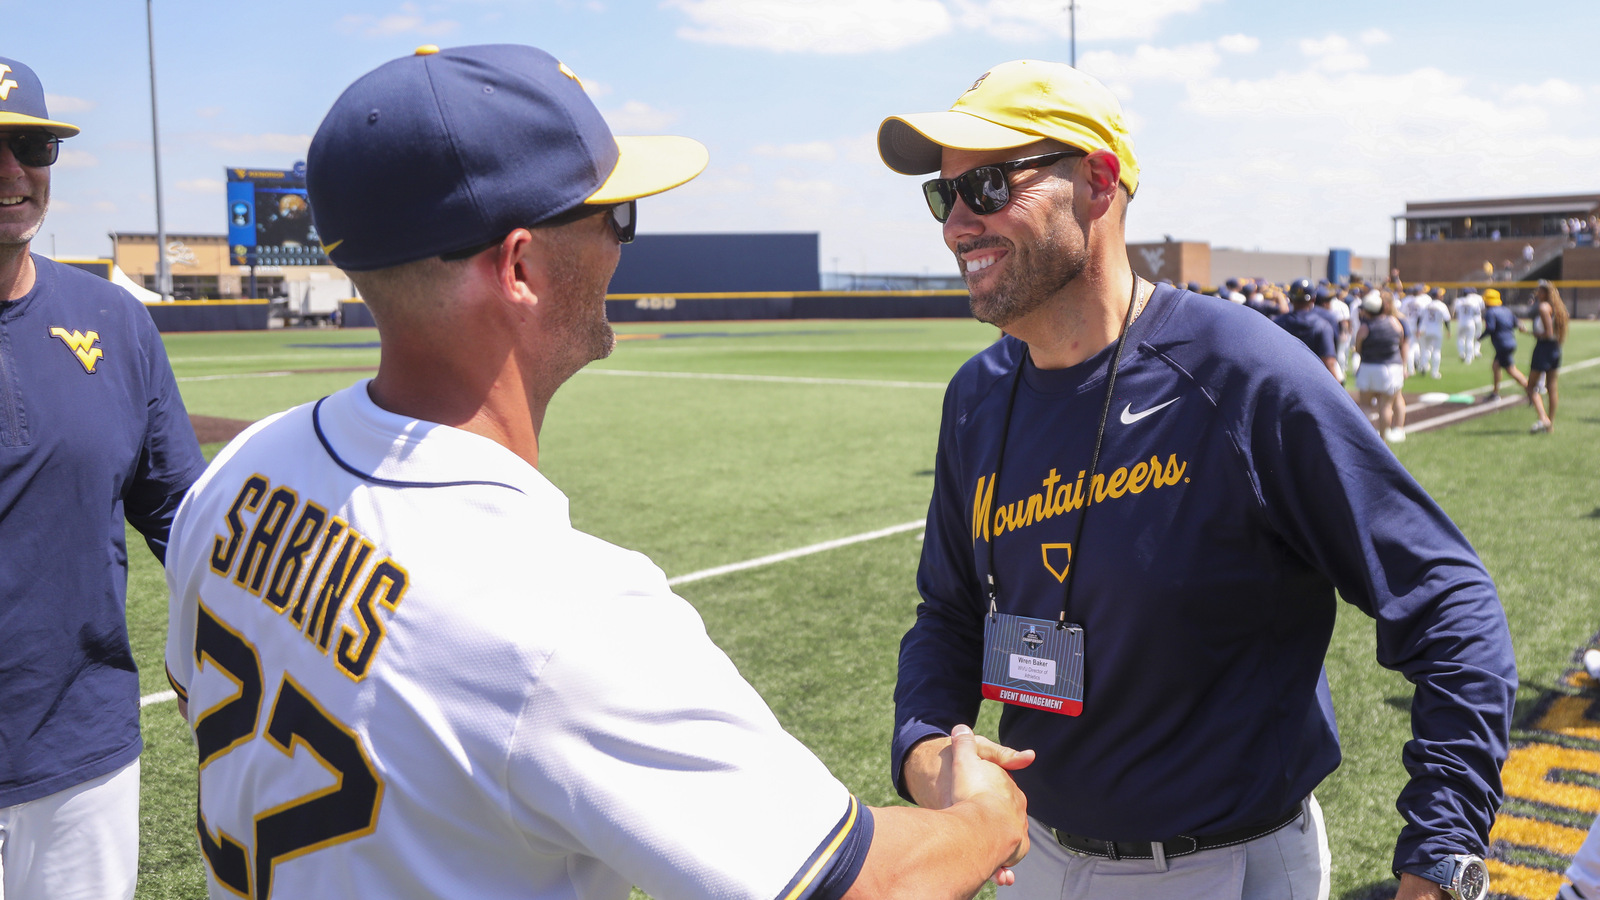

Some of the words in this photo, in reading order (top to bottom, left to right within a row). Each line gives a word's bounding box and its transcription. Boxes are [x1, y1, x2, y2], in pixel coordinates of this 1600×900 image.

[635, 296, 676, 310] 400
[972, 453, 1187, 549] Mountaineers
[210, 473, 409, 683] SABINS
[1033, 659, 1048, 667] Baker
[1000, 690, 1019, 701] EVENT
[1019, 694, 1063, 710] MANAGEMENT
